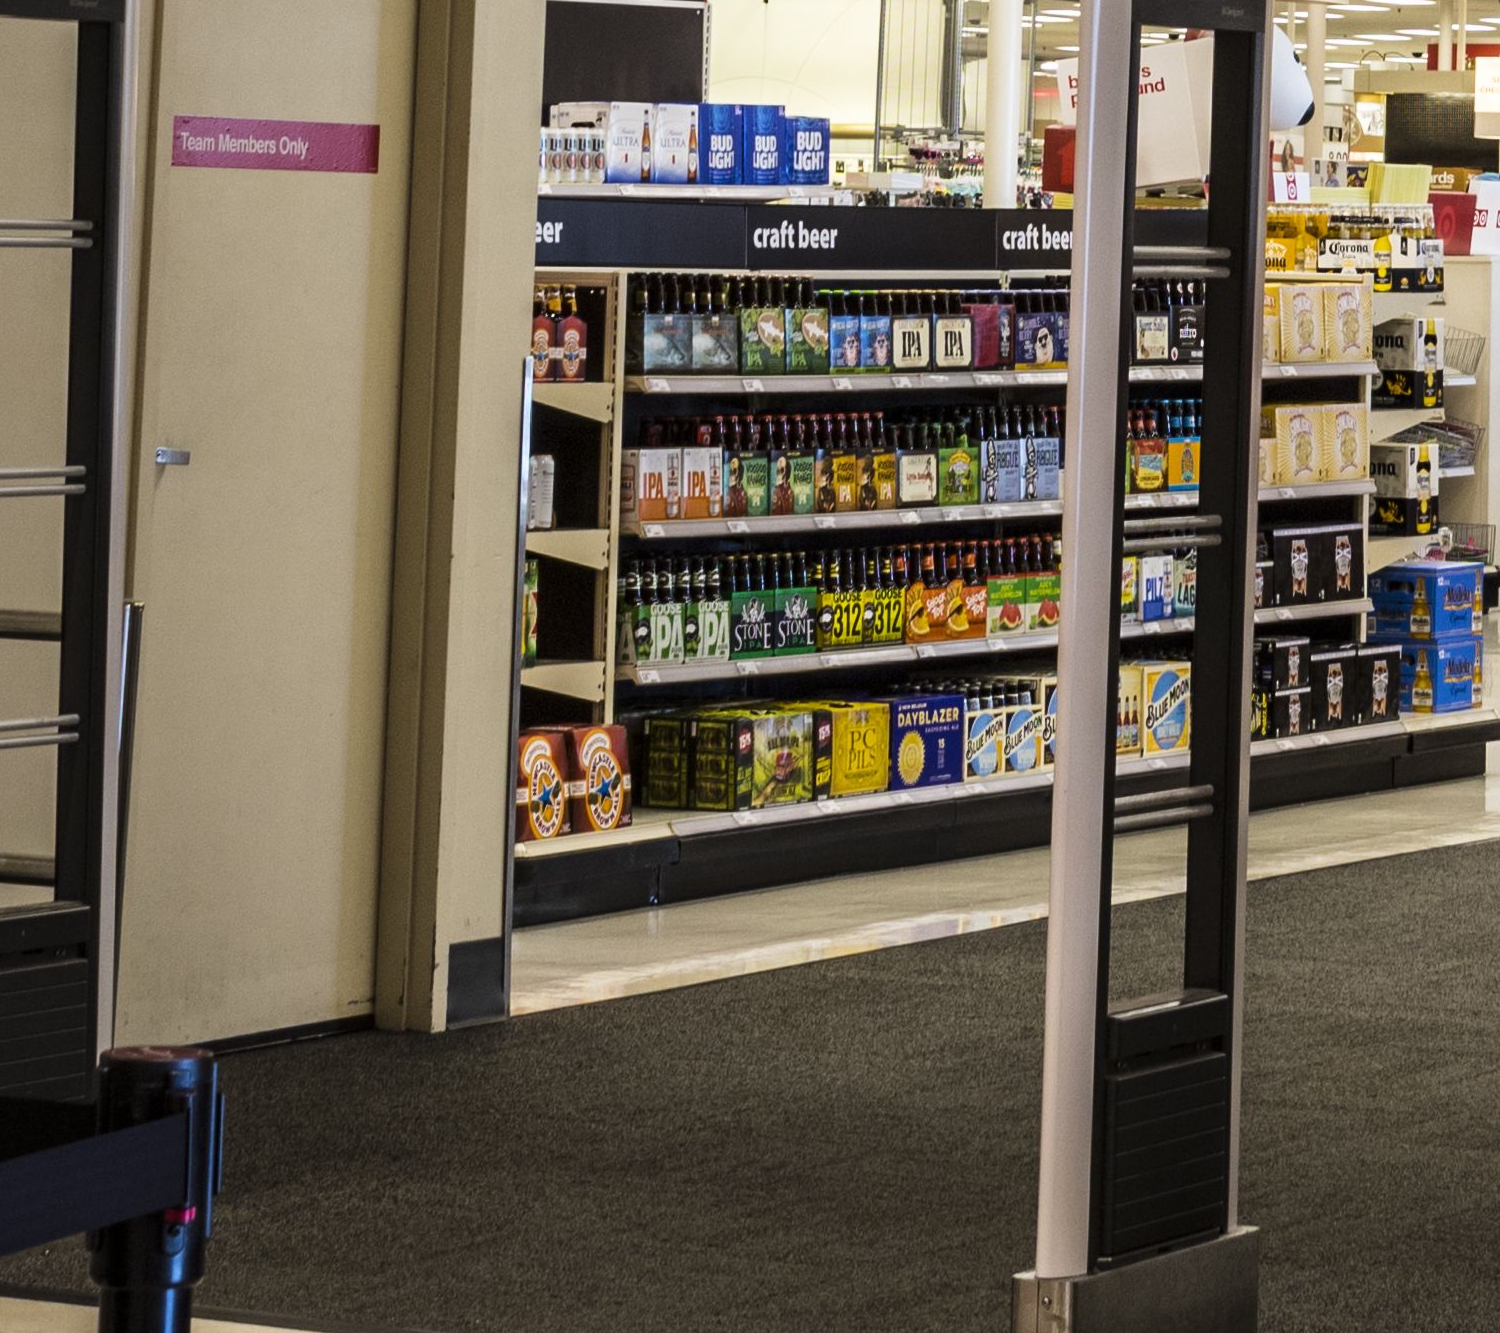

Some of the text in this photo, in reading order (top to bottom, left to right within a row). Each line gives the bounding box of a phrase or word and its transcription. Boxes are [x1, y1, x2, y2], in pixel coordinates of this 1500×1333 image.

[180, 132, 308, 160] Team Members Only
[613, 136, 639, 148] ULTRA
[660, 136, 686, 149] ULTRA
[710, 135, 733, 150] BUD
[754, 135, 777, 151] BUD
[797, 132, 822, 150] BUD
[708, 151, 735, 169] LIGHT
[753, 152, 778, 169] LIGHT
[794, 151, 824, 171] LIGHT
[1432, 171, 1455, 184] rds
[535, 222, 563, 243] eer
[753, 219, 838, 249] craft beer
[1002, 223, 1040, 250] craft
[1329, 241, 1369, 255] Corona
[1265, 255, 1286, 268] ona
[901, 330, 922, 358] IPA
[944, 330, 964, 358] IPA
[1375, 334, 1405, 350] ona
[997, 451, 1019, 468] ROGUE
[1037, 449, 1058, 466] ROGUE
[1370, 460, 1396, 477] ona
[643, 472, 664, 500] IPA
[688, 470, 707, 498] IPA
[839, 484, 851, 502] IPA
[880, 482, 892, 500] IPA
[833, 591, 862, 602] GOOSE
[875, 589, 902, 600] GOOSE
[1146, 576, 1164, 601] PILZ
[1178, 582, 1196, 606] LAG
[651, 602, 682, 615] GOOSE
[699, 599, 729, 613] GOOSE
[833, 601, 861, 639] 312
[875, 599, 901, 635] 312
[650, 614, 684, 661] IPA
[698, 613, 730, 660] IPA
[735, 621, 772, 652] STONE
[778, 618, 815, 648] STONE
[1145, 677, 1190, 729] BLUE MOON
[898, 707, 959, 728] DAYBLAZER
[850, 728, 877, 750] PC
[1004, 714, 1043, 756] BLUE MOON
[1042, 715, 1056, 742] BL
[966, 735, 983, 760] BLUE
[985, 719, 1003, 743] MOON
[848, 749, 877, 770] PILS
[532, 760, 556, 796] NEWCASTLE
[591, 753, 615, 789] NEWCASTLE
[534, 814, 556, 834] BROWN
[593, 806, 615, 826] BROWN
